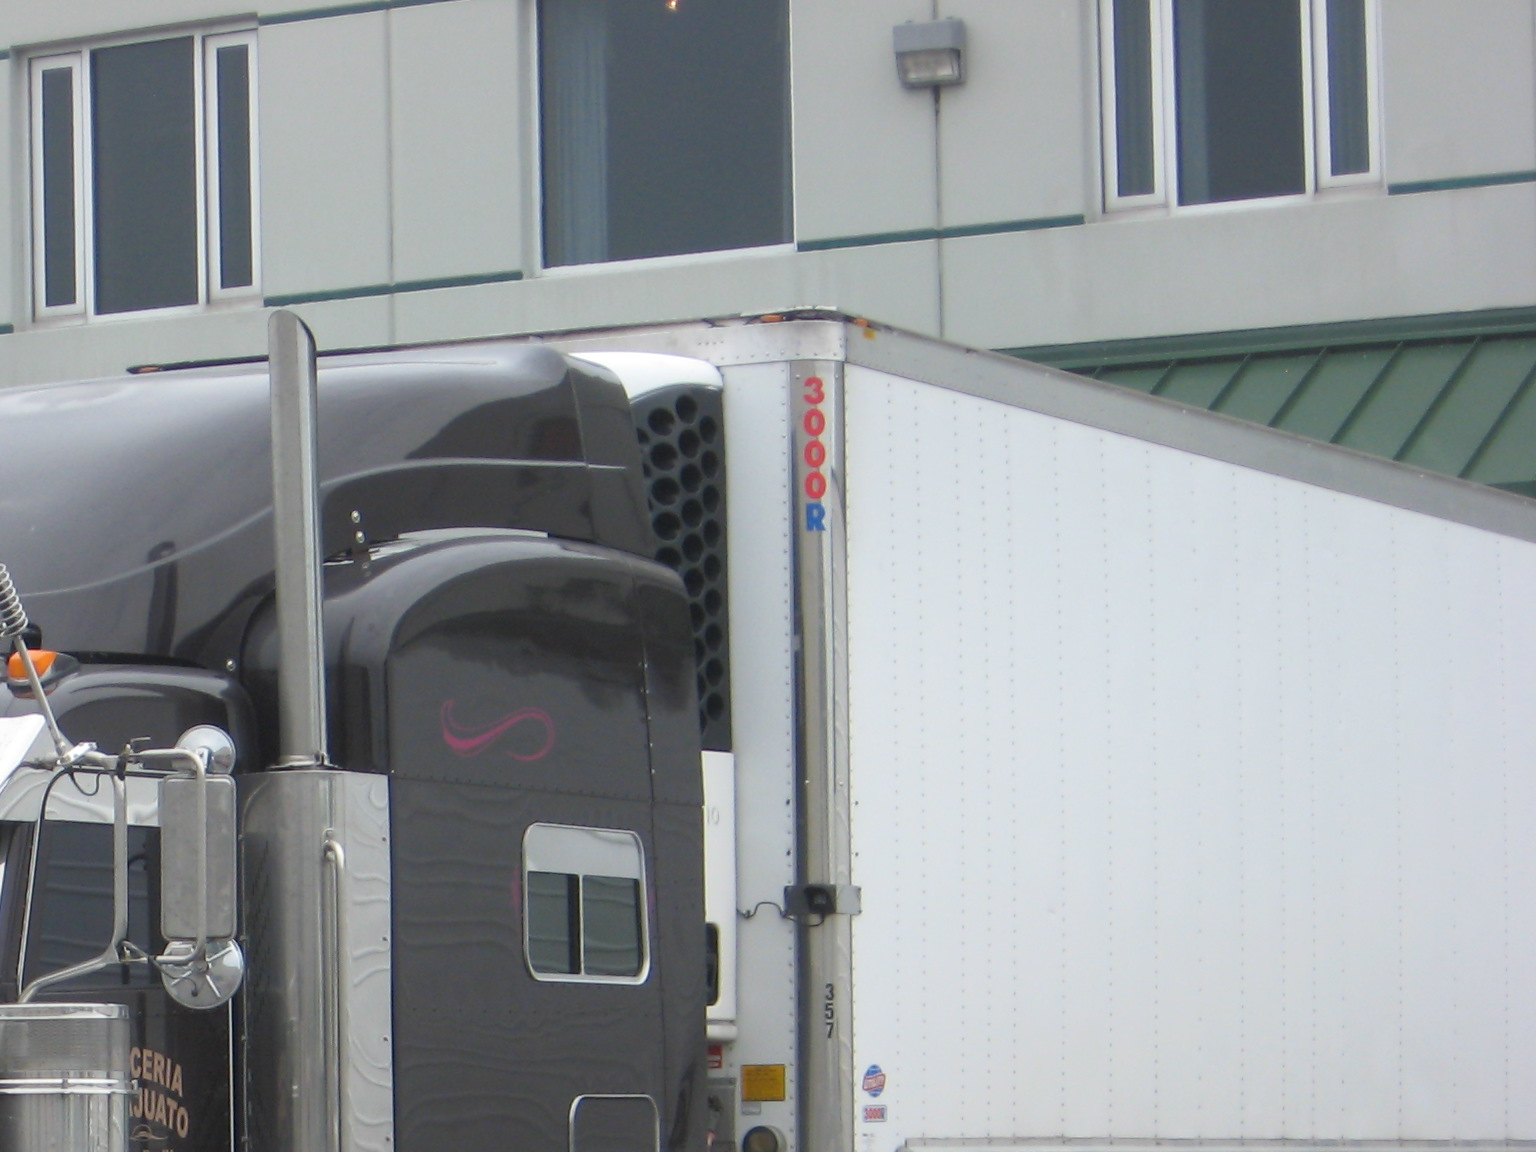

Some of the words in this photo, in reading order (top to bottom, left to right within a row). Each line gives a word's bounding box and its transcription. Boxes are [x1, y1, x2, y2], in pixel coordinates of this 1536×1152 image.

[803, 376, 827, 532] 3000R
[825, 983, 835, 1039] 357
[130, 1046, 184, 1098] CERIA
[129, 1087, 189, 1138] JUATO
